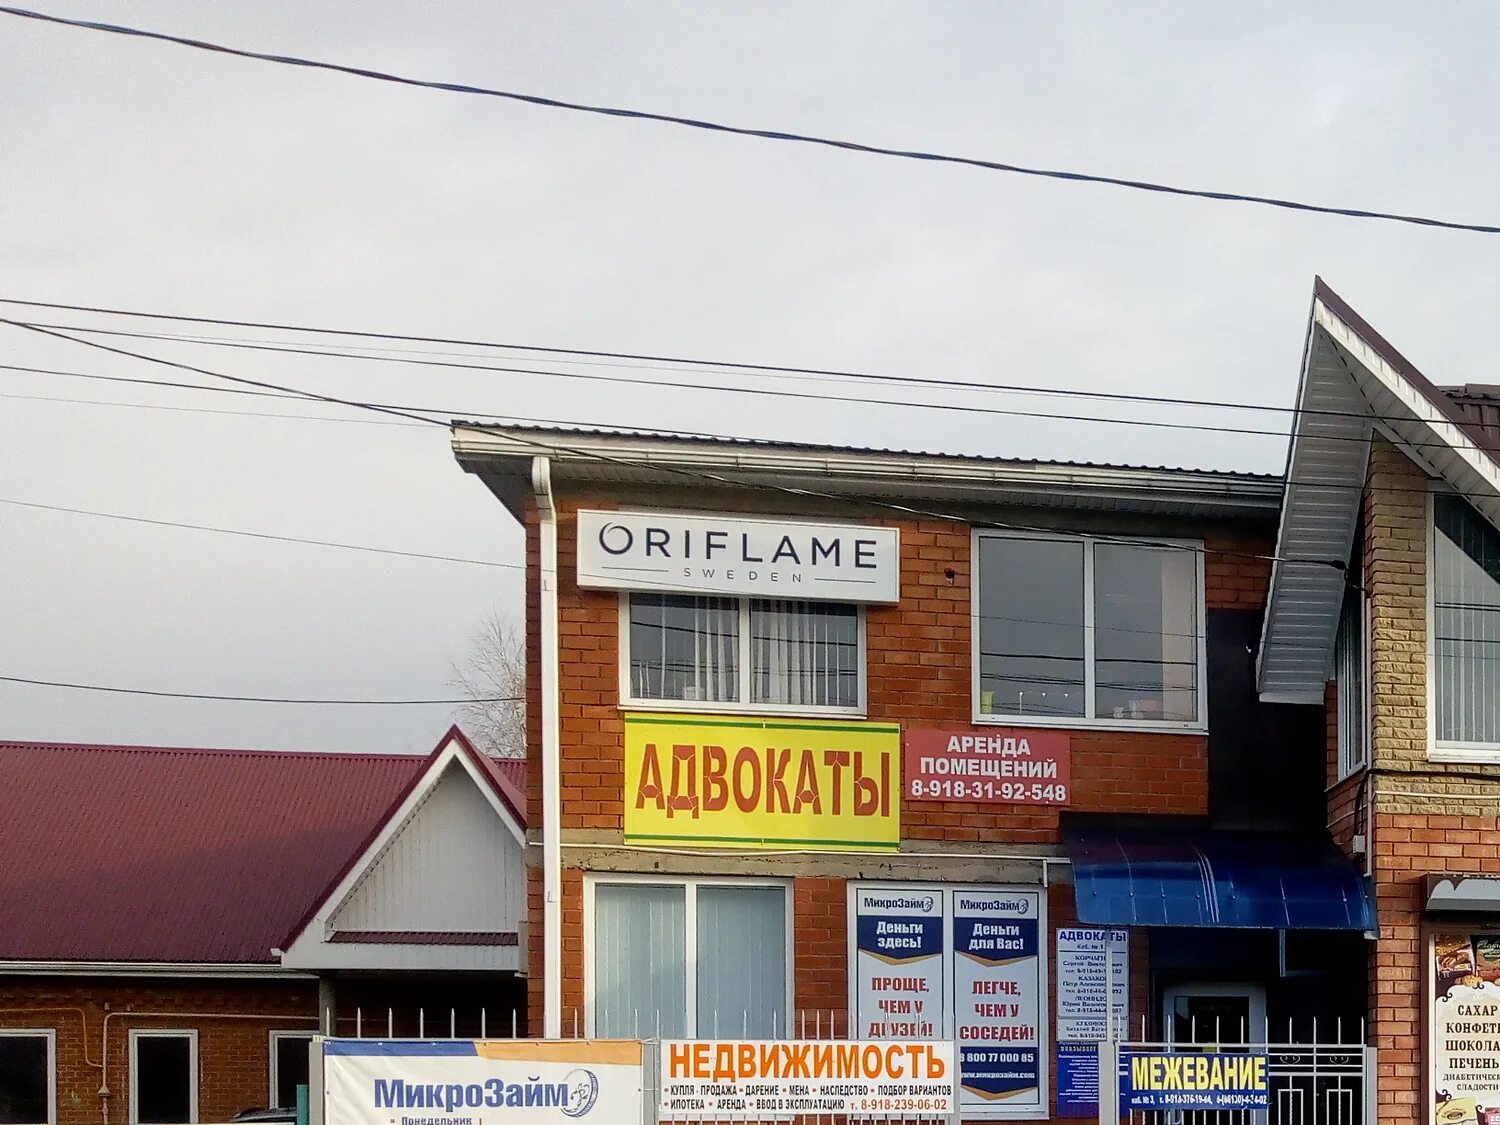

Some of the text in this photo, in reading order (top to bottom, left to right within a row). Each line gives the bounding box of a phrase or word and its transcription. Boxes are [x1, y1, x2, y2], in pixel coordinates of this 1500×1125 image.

[598, 521, 877, 570] ORIFLAME
[683, 567, 802, 584] SWEDEN
[946, 734, 1031, 756] АРЕНДА
[920, 755, 1058, 783] ПОМЕЩЕНИЙ
[635, 742, 890, 820] АДВОКАТЫ
[910, 779, 1067, 803] 8-918-31-92-548
[864, 897, 925, 909] МикроЗайм
[960, 899, 1020, 911] МикроЗайм
[876, 921, 923, 935] Деньги
[972, 923, 1020, 937] Деньги
[877, 937, 922, 949] здесь!
[968, 938, 1024, 951] для Вас!
[871, 977, 930, 994] ПРОЩЕ,
[971, 980, 1021, 997] ЛЕГЧЕ,
[878, 1000, 911, 1014] ЧЕМ
[974, 1003, 1020, 1018] ЧЕМ У
[1457, 1005, 1498, 1016] САХАР
[959, 1024, 1035, 1042] СОСЕДЕЙ!
[669, 1043, 946, 1082] НЕДВИЖИМОСТЬ
[966, 1053, 987, 1063] 800
[988, 1053, 999, 1063] 77
[1000, 1053, 1019, 1063] 000
[1131, 1056, 1267, 1091] МЕЖЕВАНИЕ
[373, 1075, 569, 1112] МикроЗайм
[670, 1084, 952, 1096] КУПЛЯ ПРОДАЖА ДАРЕНИЕ МЕНА НАСЛЕДСТВО ПОДБОР ВАРИАНТОВ
[1456, 1083, 1499, 1091] СЛАДОСТИ
[670, 1099, 947, 1110] ИПОТЕКА АРЕНДА ВВОД В ЭКСПЛУАТАЦИЮ т. 8-918-239-06-02
